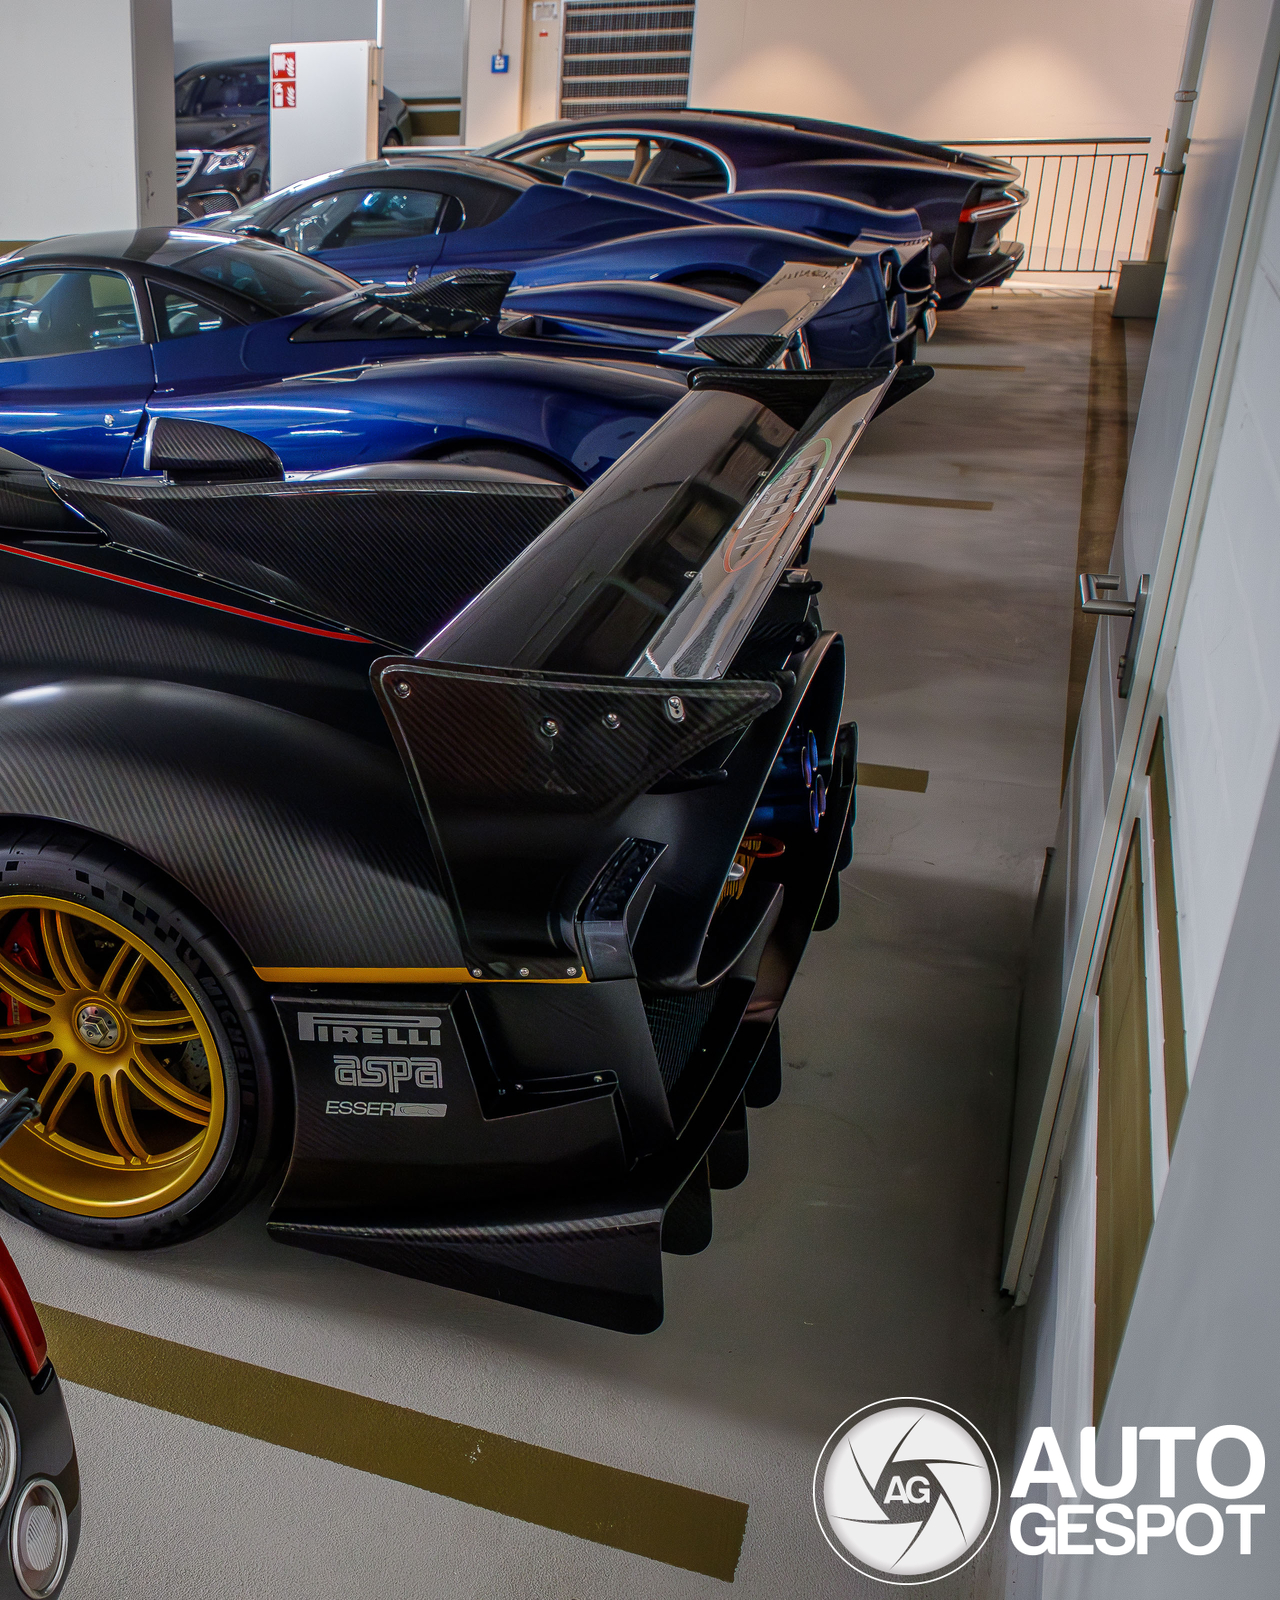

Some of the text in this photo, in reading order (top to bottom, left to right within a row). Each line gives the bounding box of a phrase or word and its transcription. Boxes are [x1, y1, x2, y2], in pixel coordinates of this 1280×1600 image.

[297, 1012, 442, 1046] PIRELLI
[333, 1055, 443, 1093] aspa
[325, 1100, 395, 1116] ESSER
